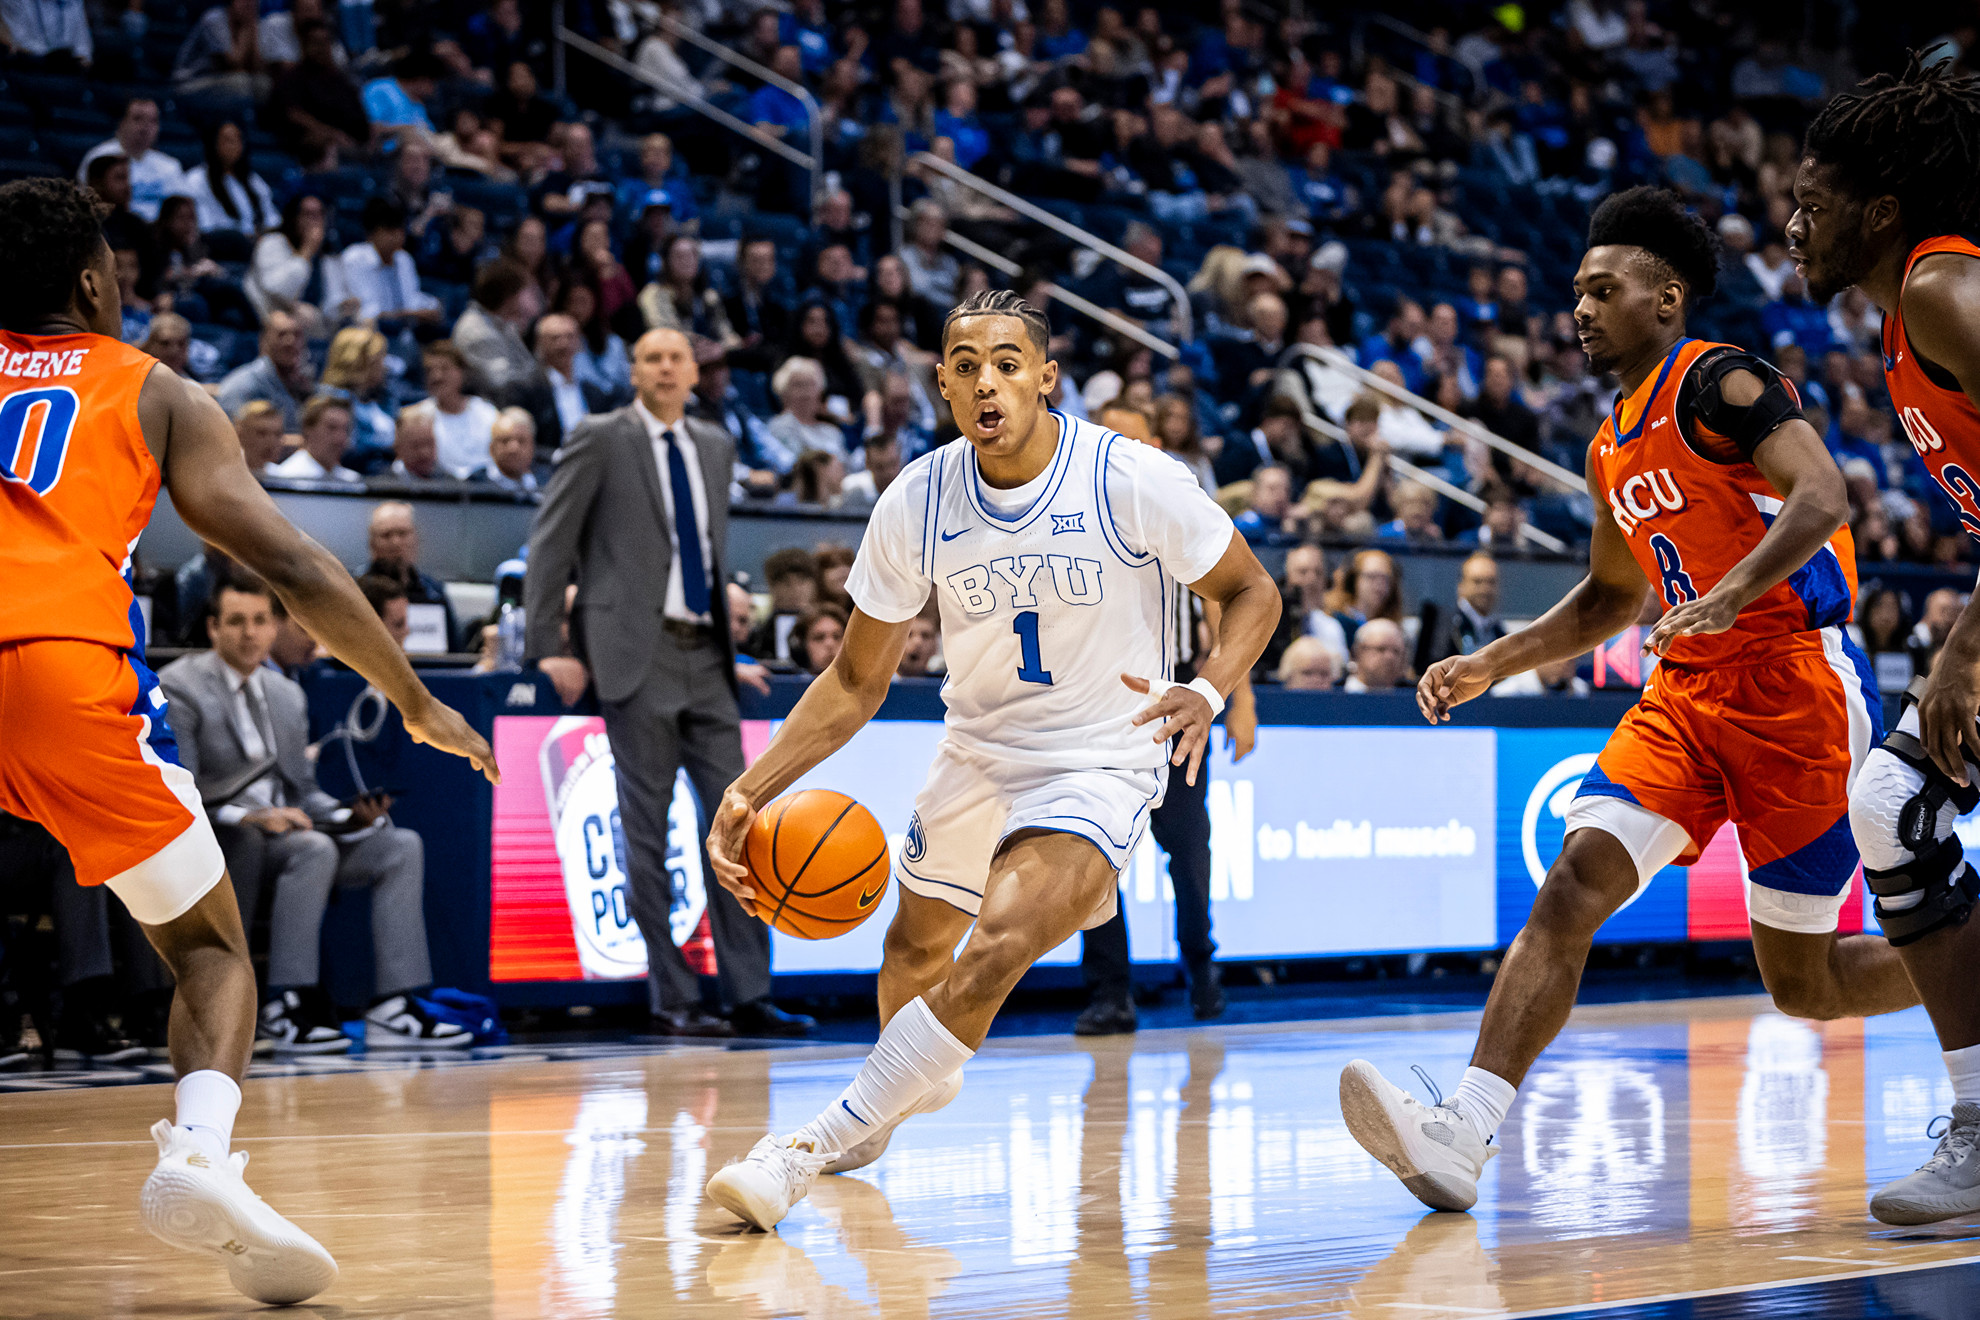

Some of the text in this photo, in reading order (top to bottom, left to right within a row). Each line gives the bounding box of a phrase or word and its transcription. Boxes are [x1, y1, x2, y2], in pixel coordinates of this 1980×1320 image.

[0, 386, 80, 497] 0
[1609, 468, 1687, 538] ACU
[946, 554, 1104, 615] BYU
[1649, 533, 1699, 606] 8
[1013, 610, 1055, 686] 1
[1257, 822, 1293, 861] to
[1915, 806, 1926, 840] FUSION
